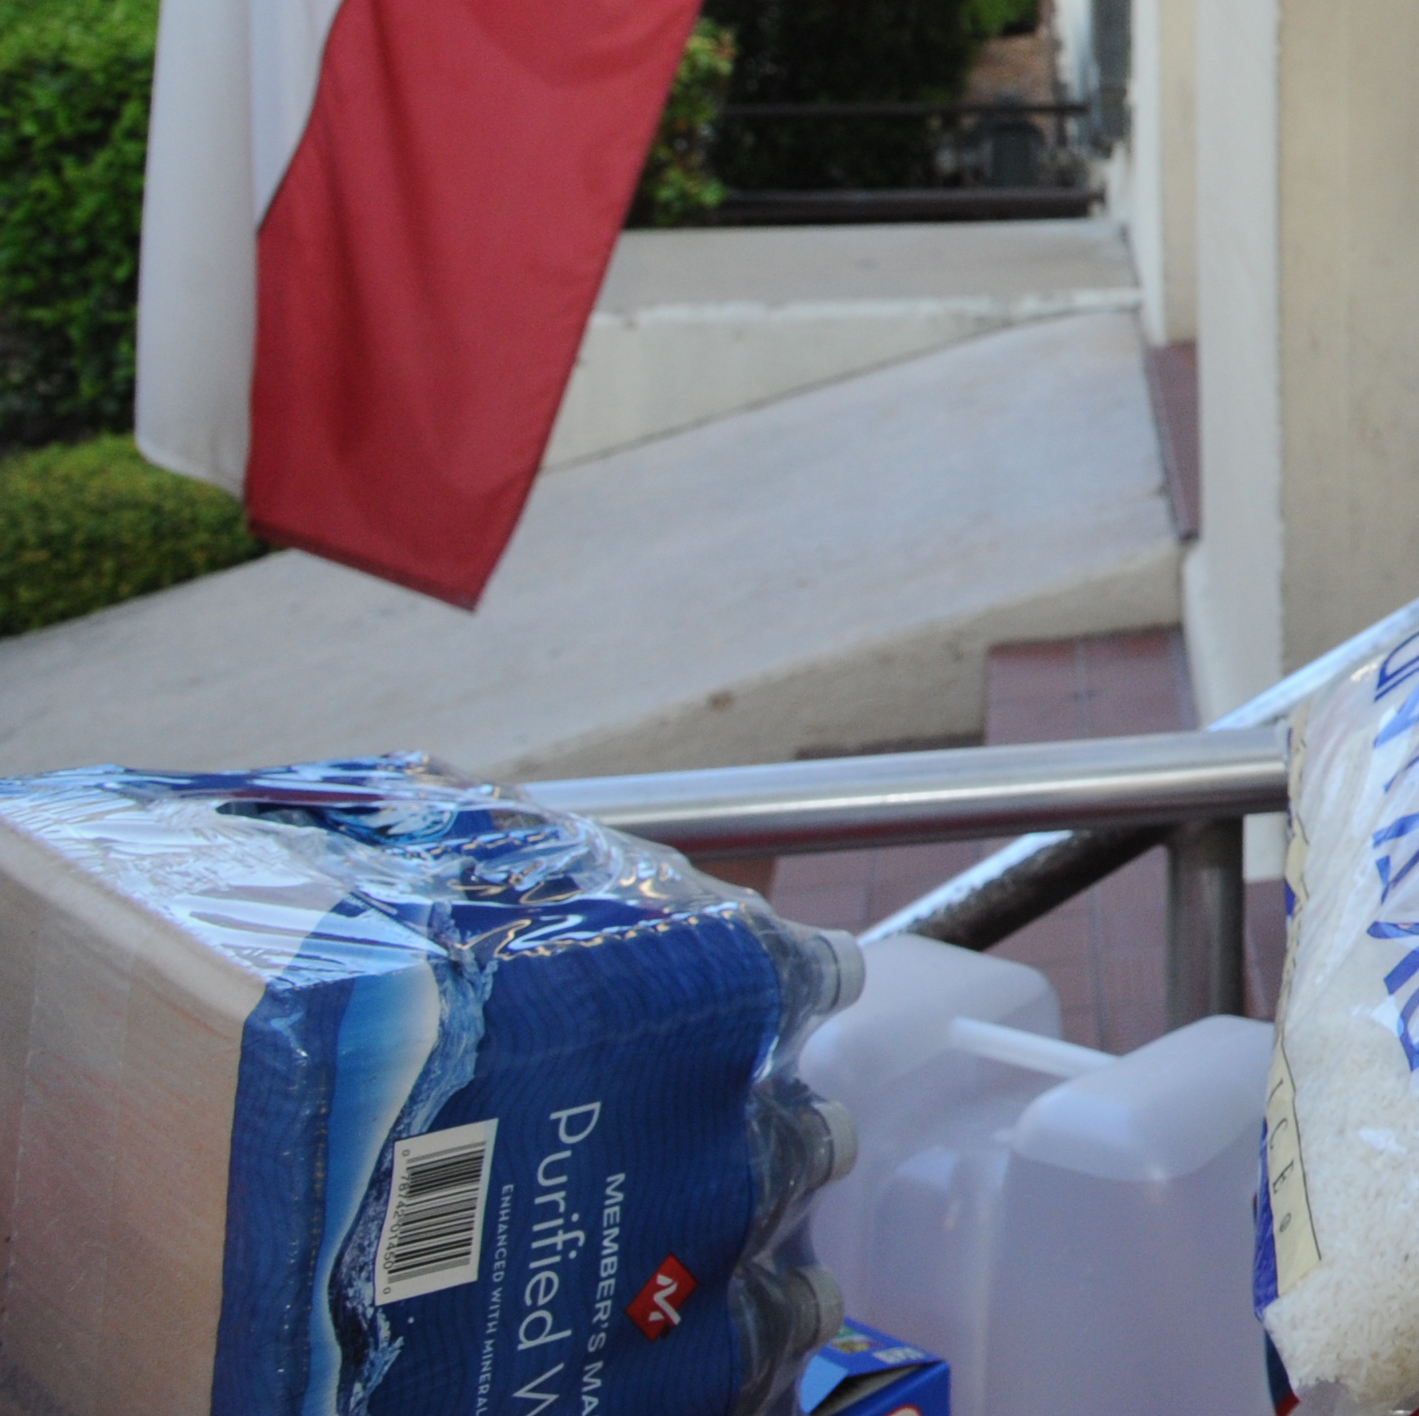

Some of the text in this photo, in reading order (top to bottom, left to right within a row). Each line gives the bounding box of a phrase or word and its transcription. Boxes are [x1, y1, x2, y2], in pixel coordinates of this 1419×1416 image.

[492, 1184, 514, 1282] ENHANCED
[517, 1101, 602, 1351] Purified
[588, 1173, 626, 1353] MEMBER'S
[486, 1288, 503, 1334] WITH
